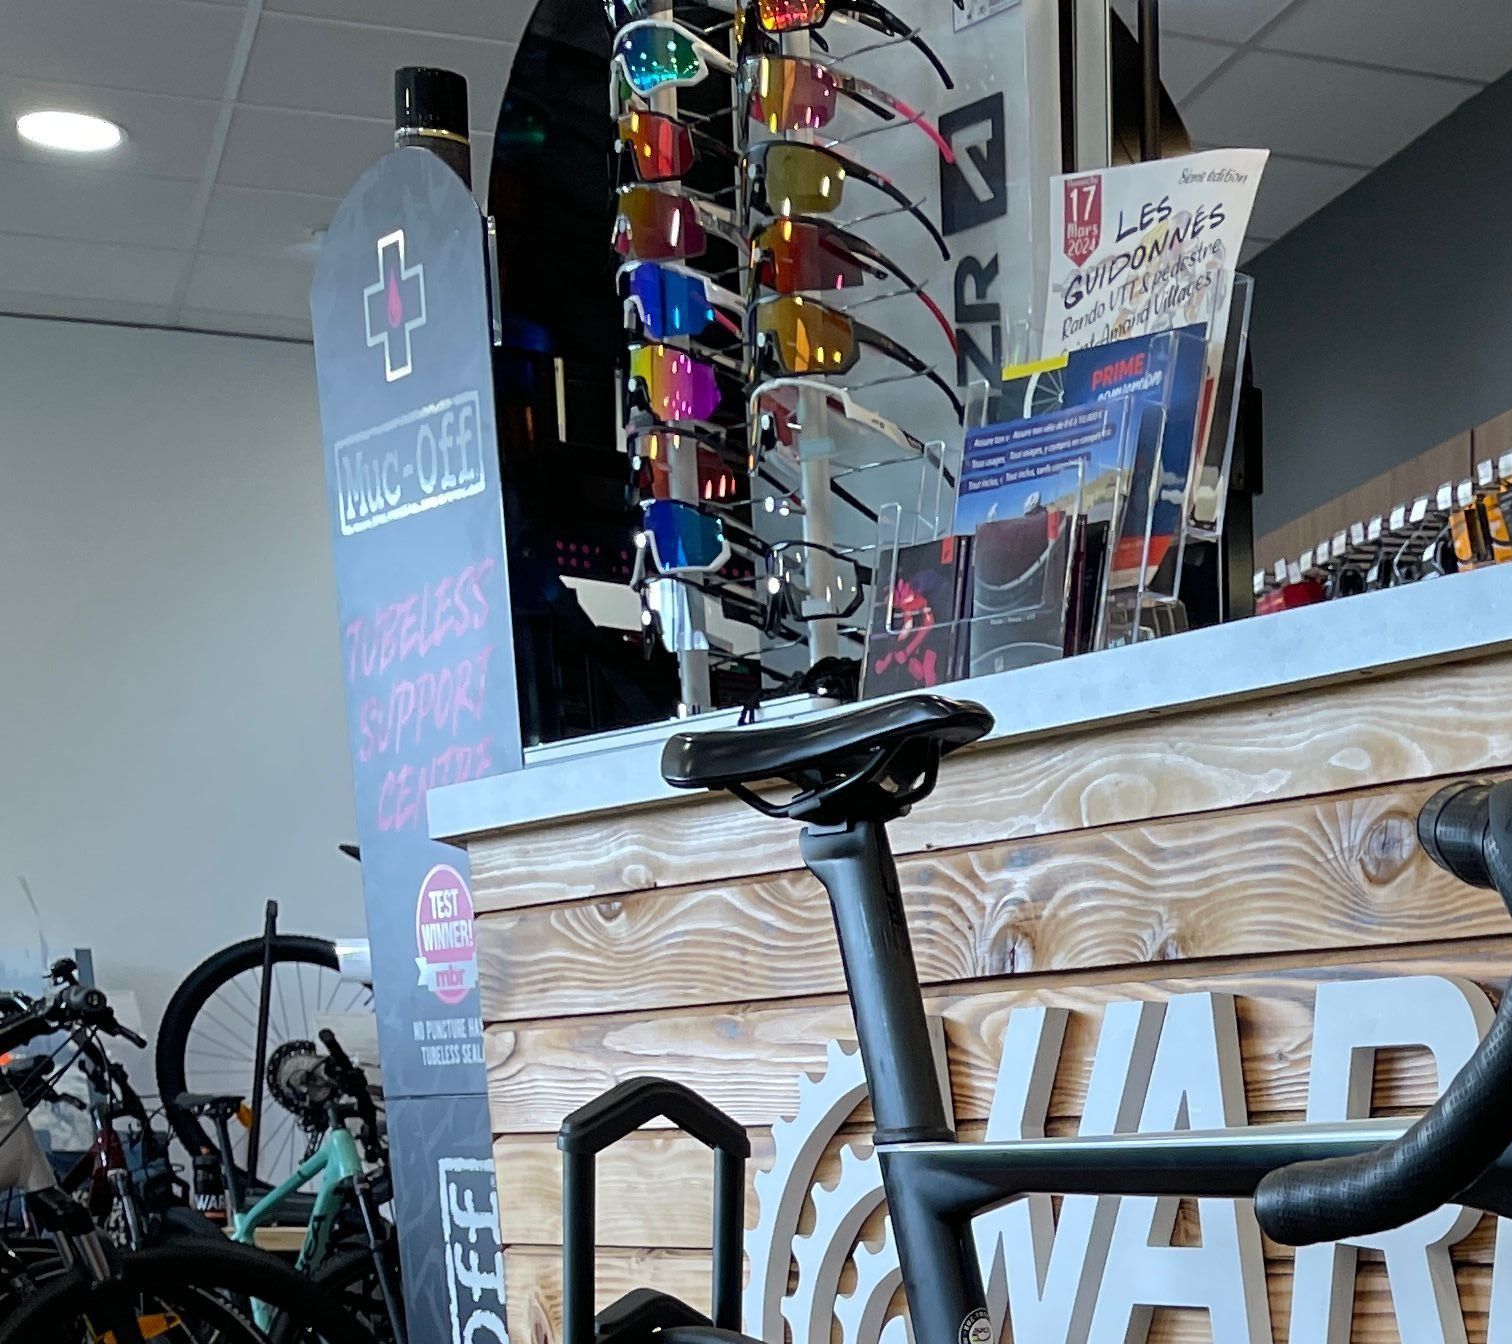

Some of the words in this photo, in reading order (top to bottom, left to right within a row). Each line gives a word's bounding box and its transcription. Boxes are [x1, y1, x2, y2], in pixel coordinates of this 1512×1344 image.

[1069, 185, 1097, 223] 17
[1115, 195, 1172, 243] LES
[1067, 223, 1099, 239] Mars
[1067, 238, 1097, 257] 2024
[1091, 352, 1146, 391] PRIME
[342, 405, 475, 520] Muc-Off
[346, 557, 495, 683] TUBELESS
[358, 644, 494, 763] SUPPORT
[428, 888, 459, 920] TEST
[420, 919, 474, 952] WINNER!
[435, 965, 465, 988] mbr
